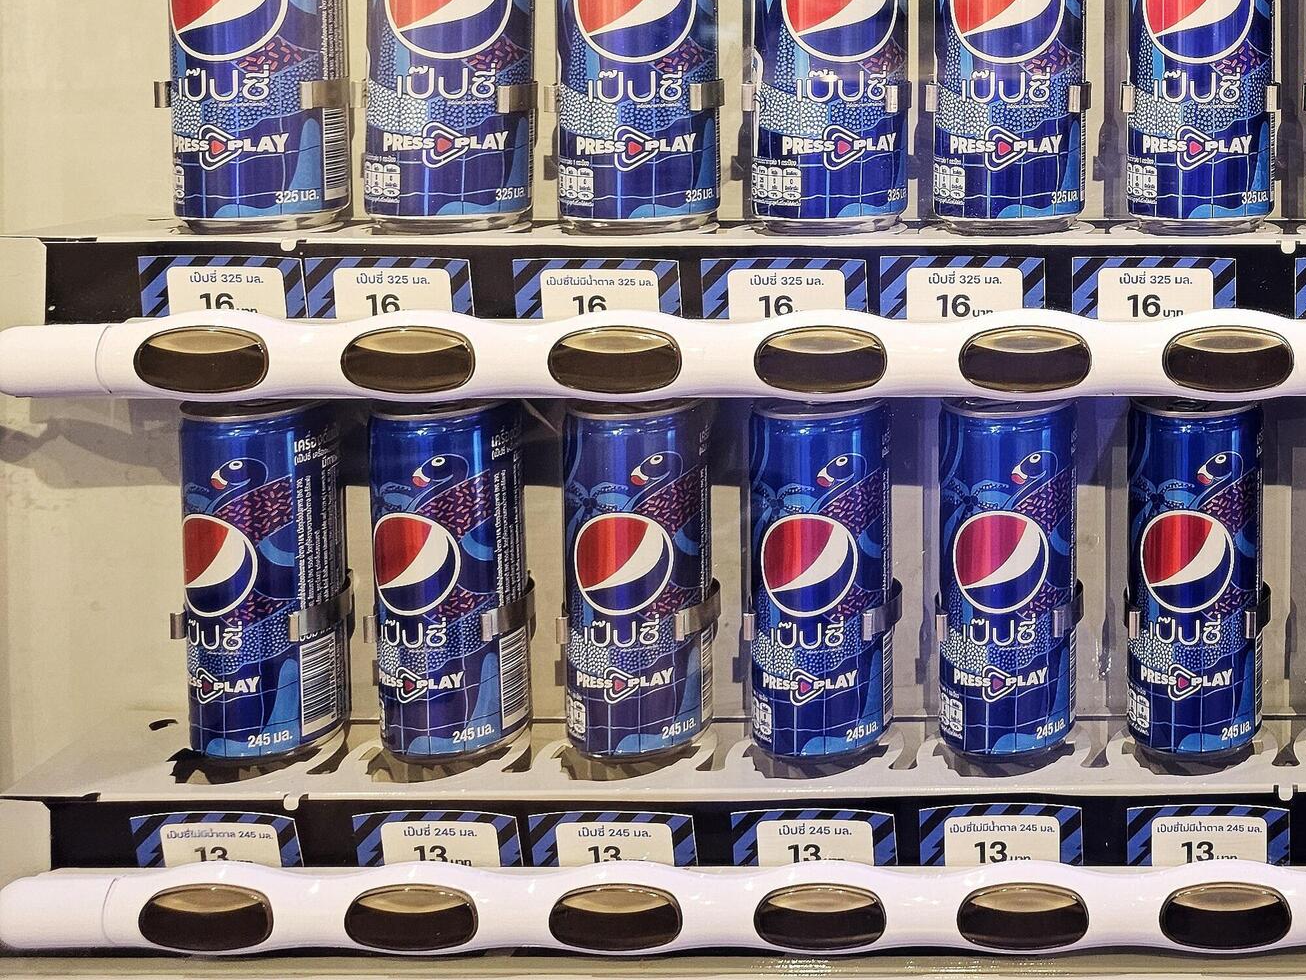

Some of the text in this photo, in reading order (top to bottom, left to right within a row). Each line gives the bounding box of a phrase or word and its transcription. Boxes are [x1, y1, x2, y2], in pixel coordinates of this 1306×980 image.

[178, 63, 270, 101] เป๊ปซี่
[398, 62, 497, 101] เป๊ปซี่
[588, 66, 683, 102] เป๊ปซี่
[962, 68, 1051, 102] เป๊ปซี่
[1152, 67, 1241, 103] เป๊ปซี่
[384, 131, 508, 151] PRESS PLAY
[576, 133, 696, 154] PRESS PLAY
[950, 134, 1063, 155] PRESS PLAY
[1142, 134, 1252, 154] PRESS PLAY
[275, 189, 298, 204] 325
[1241, 191, 1258, 204] 325
[220, 274, 242, 283] 325
[959, 275, 981, 284] 325
[1150, 275, 1171, 284] 325
[1127, 294, 1183, 317] 16 บาท
[584, 615, 660, 648] เป๊ปซี่
[771, 616, 845, 650] เป๊ปซี่
[962, 613, 1036, 647] เป๊ปซี่
[763, 670, 858, 691] PRESS PLAY
[954, 668, 1047, 686] PRESS PLAY
[248, 733, 270, 748] 245
[452, 727, 475, 744] 245
[662, 723, 681, 739] 245
